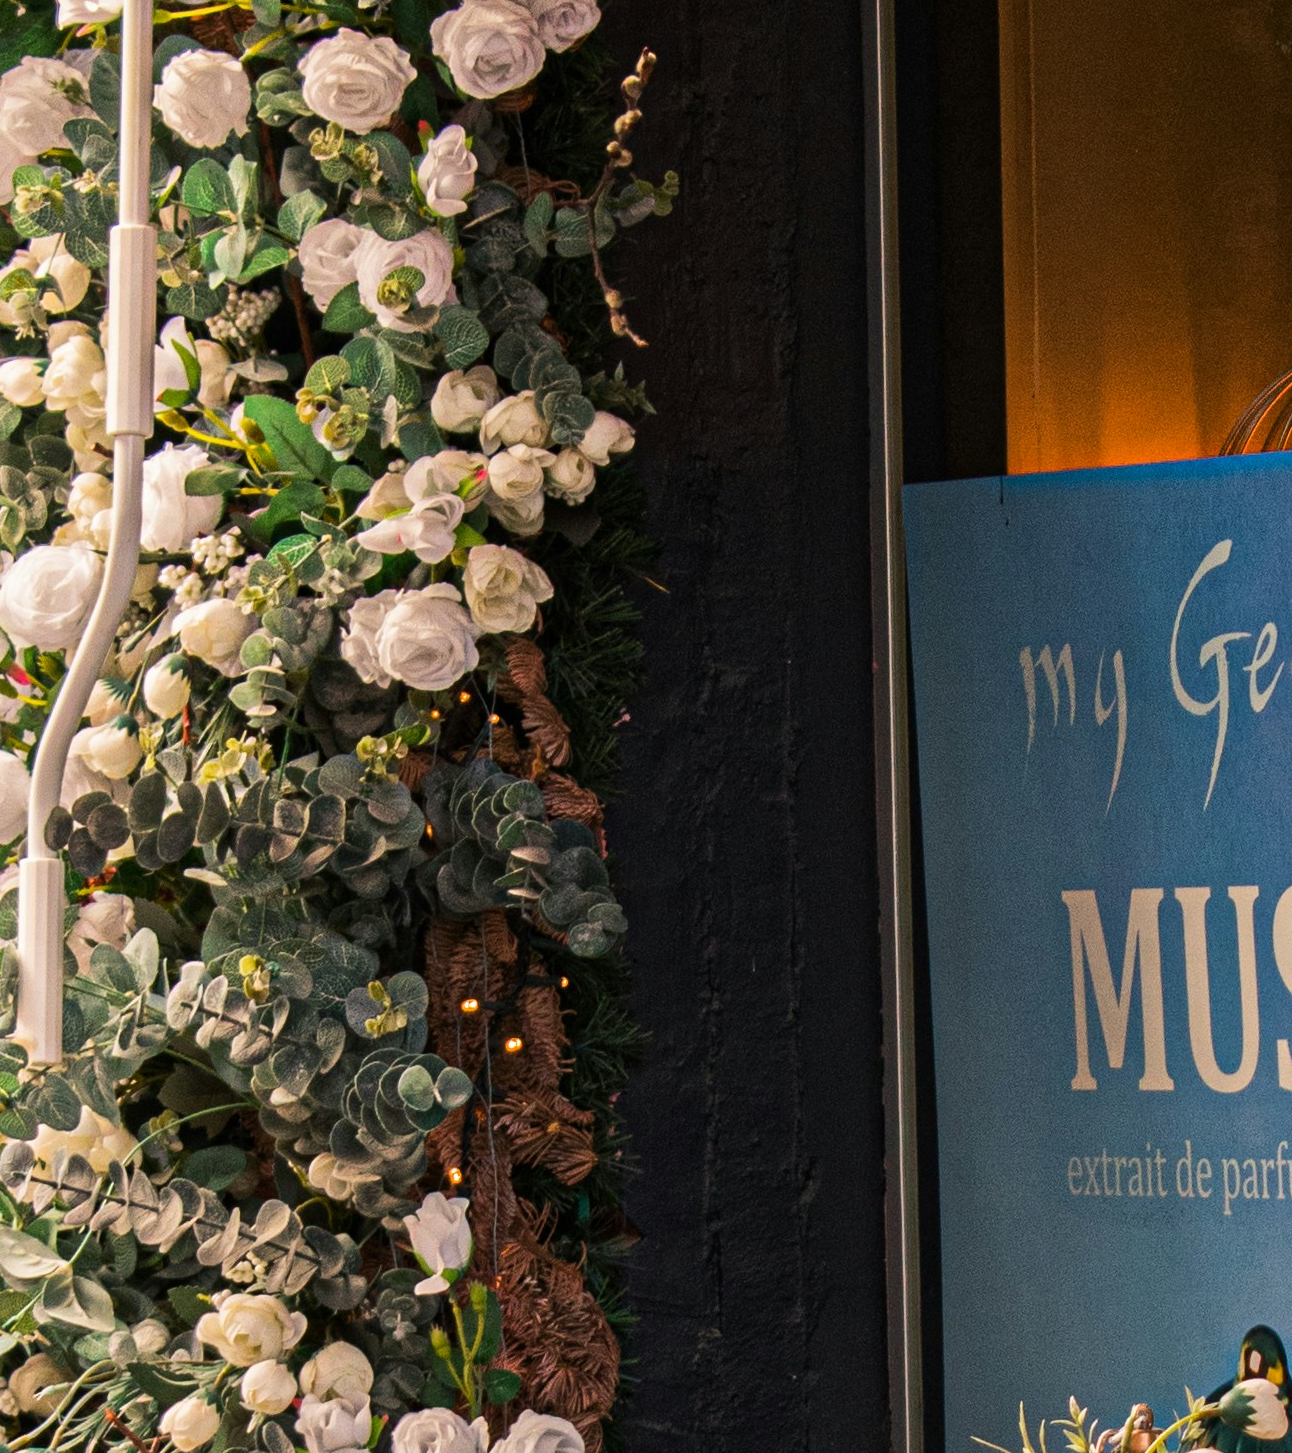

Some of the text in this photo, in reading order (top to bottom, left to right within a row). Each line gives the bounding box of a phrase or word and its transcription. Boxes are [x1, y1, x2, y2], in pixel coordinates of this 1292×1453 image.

[1019, 643, 1127, 816] my
[1067, 1143, 1168, 1198] extrait
[1176, 1140, 1212, 1198] de
